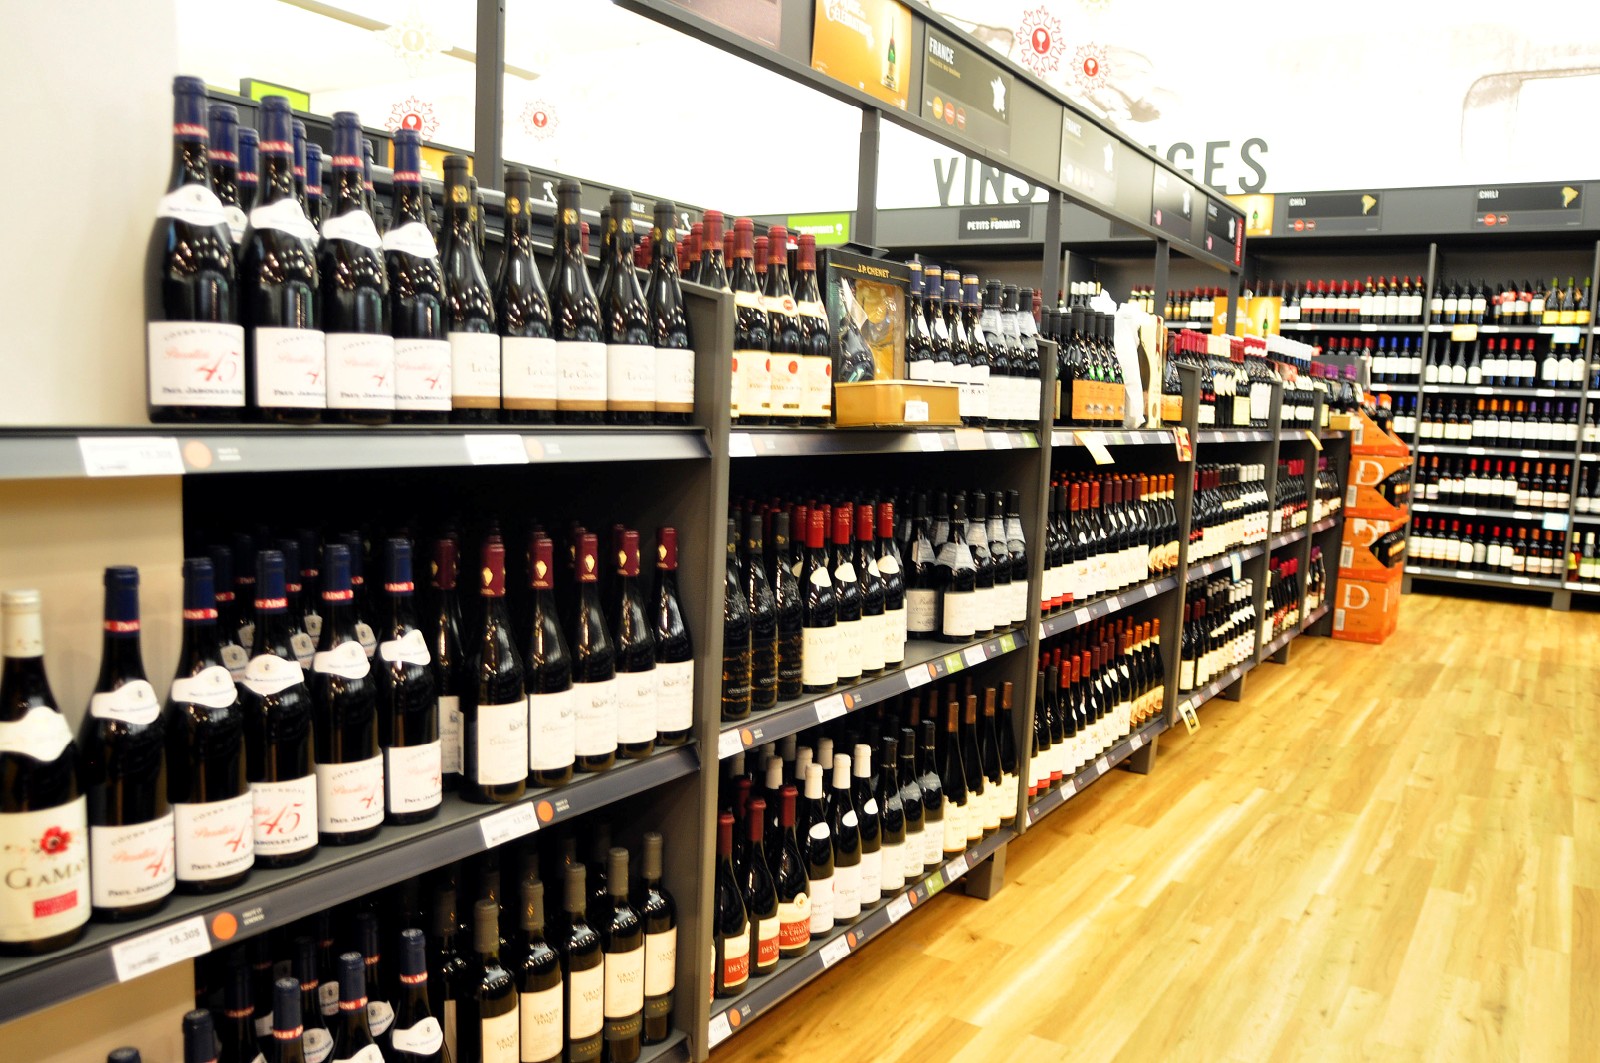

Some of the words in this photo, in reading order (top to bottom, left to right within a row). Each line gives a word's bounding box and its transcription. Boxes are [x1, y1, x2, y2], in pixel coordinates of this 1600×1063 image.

[928, 36, 956, 65] FRANCE
[934, 156, 1037, 206] VINS
[1148, 137, 1269, 195] GES
[1289, 197, 1307, 207] CHILI
[1479, 189, 1499, 199] CHILI
[966, 220, 990, 231] PETITS
[990, 219, 1021, 230] FORMATS
[1355, 459, 1385, 486] D
[1343, 583, 1370, 610] D
[258, 802, 304, 835] 45
